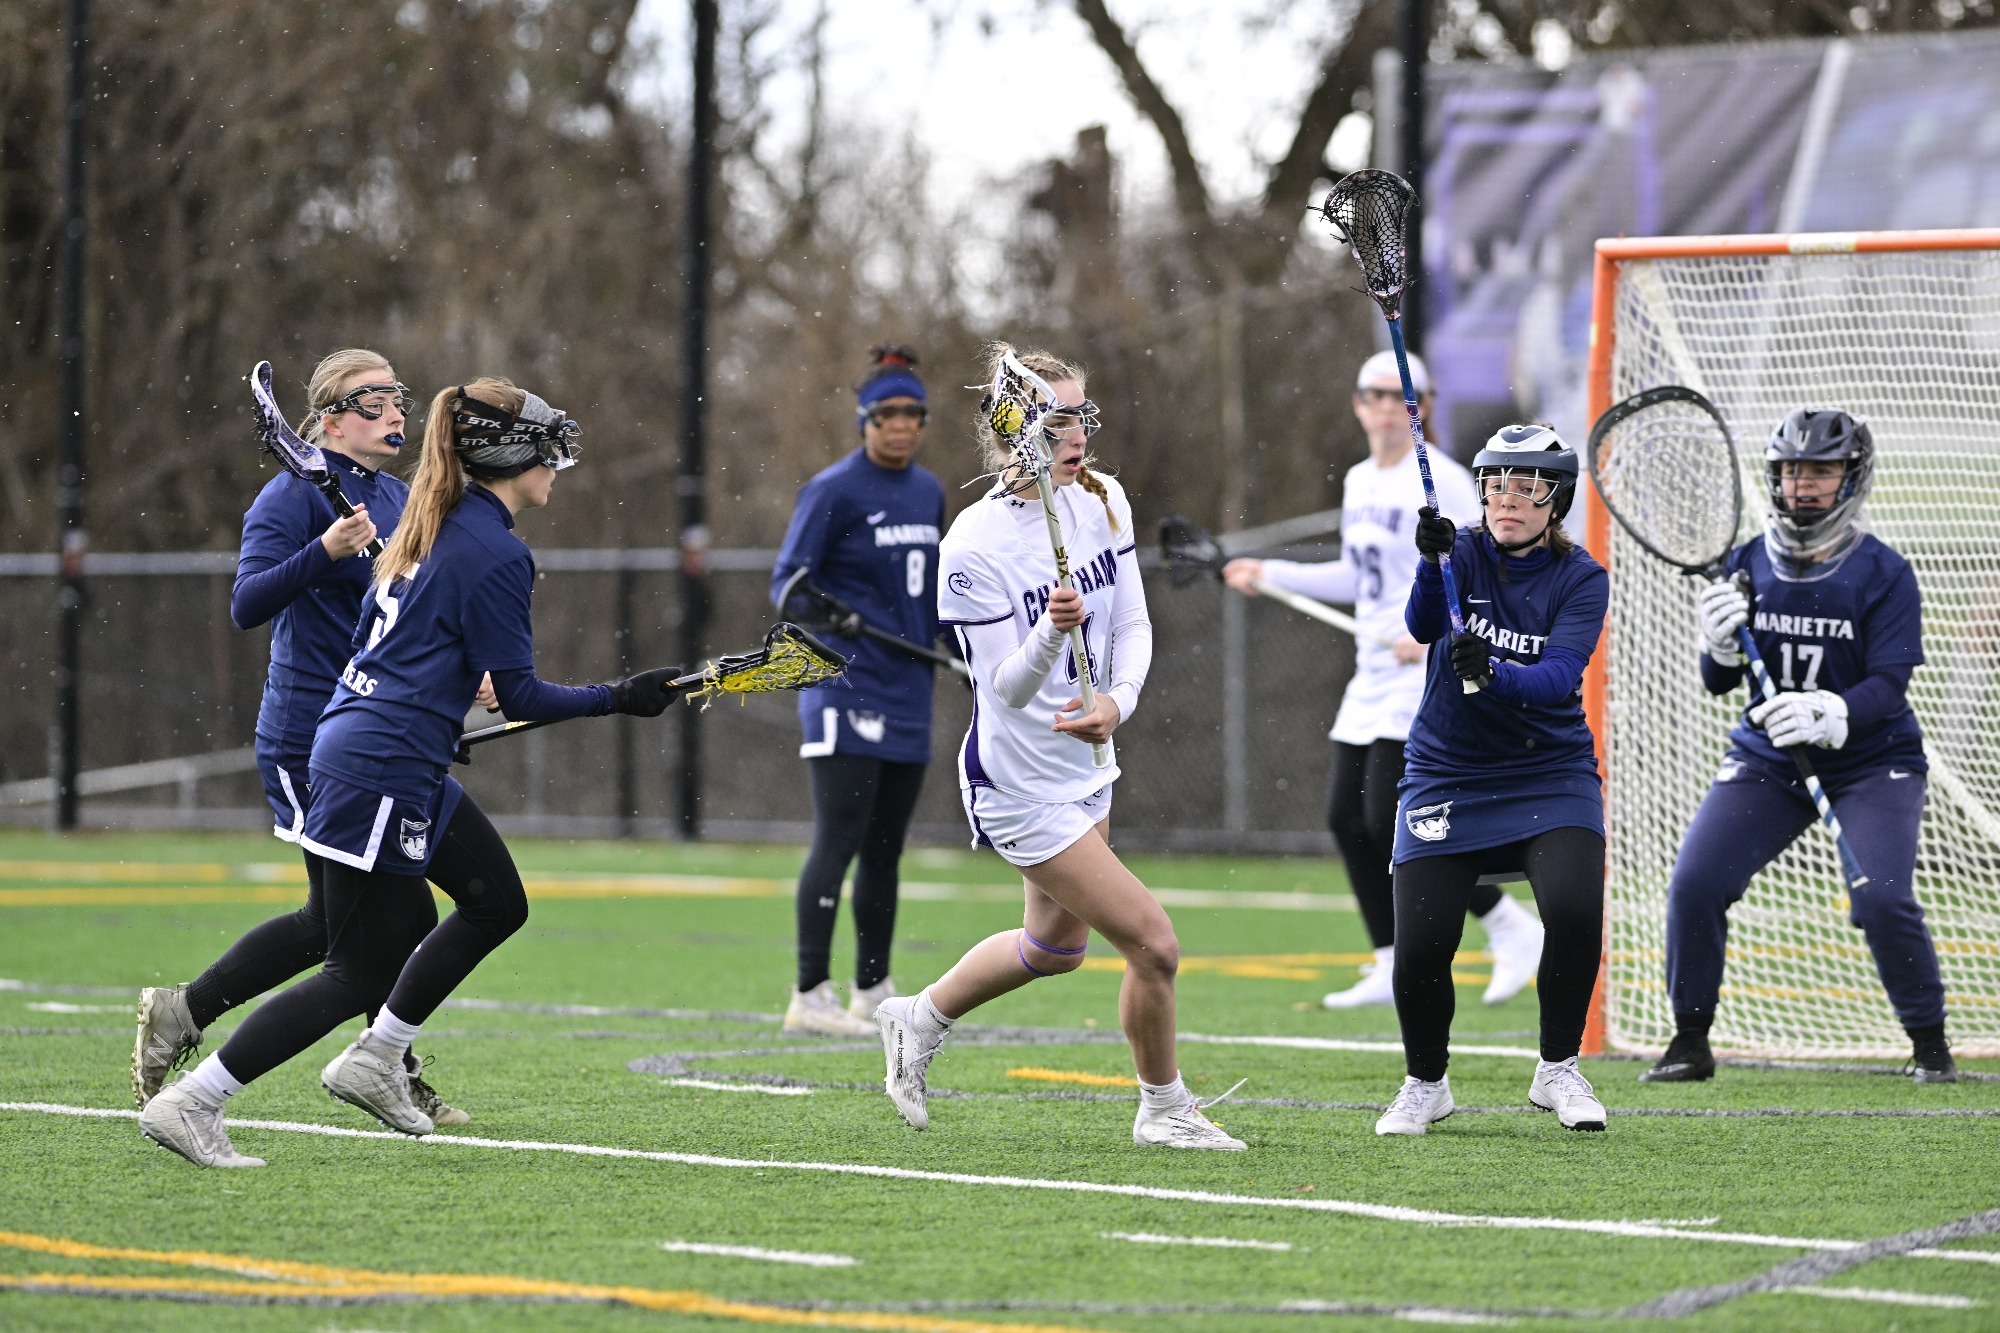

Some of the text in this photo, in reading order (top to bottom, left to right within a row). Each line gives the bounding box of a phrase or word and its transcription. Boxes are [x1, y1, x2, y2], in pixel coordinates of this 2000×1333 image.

[460, 437, 489, 446] STX
[499, 433, 531, 444] STX
[467, 416, 501, 429] STX
[513, 422, 548, 434] STX
[906, 548, 926, 598] 8
[1022, 546, 1117, 628] CHHAM
[1464, 612, 1549, 655] MARIET
[1754, 610, 1855, 640] MARIETTA
[1064, 611, 1099, 687] 4
[1779, 642, 1824, 691] 17
